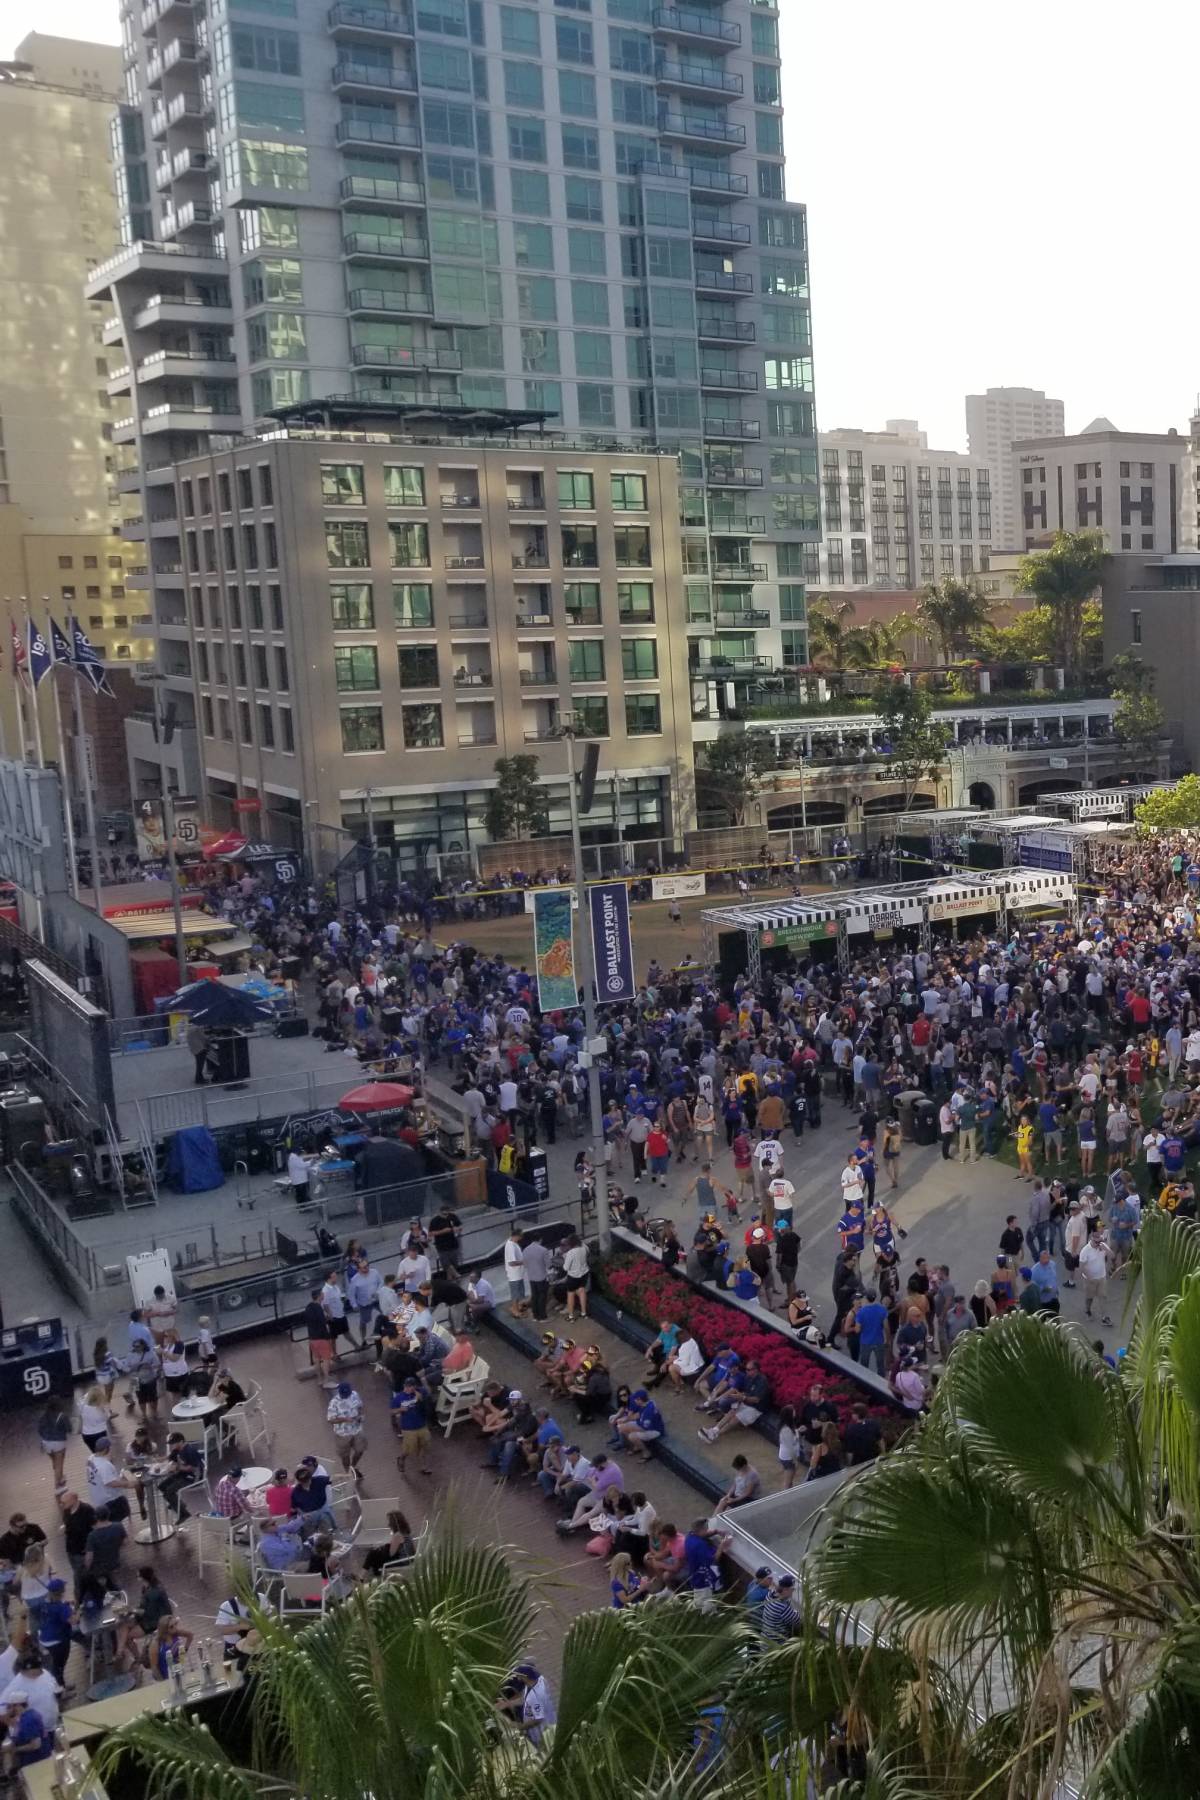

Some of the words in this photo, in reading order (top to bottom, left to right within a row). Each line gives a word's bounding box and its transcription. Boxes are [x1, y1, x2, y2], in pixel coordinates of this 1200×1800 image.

[142, 800, 152, 815] 4
[603, 894, 613, 927] POINT
[606, 928, 618, 975] BALLAST
[23, 1365, 51, 1396] SD
